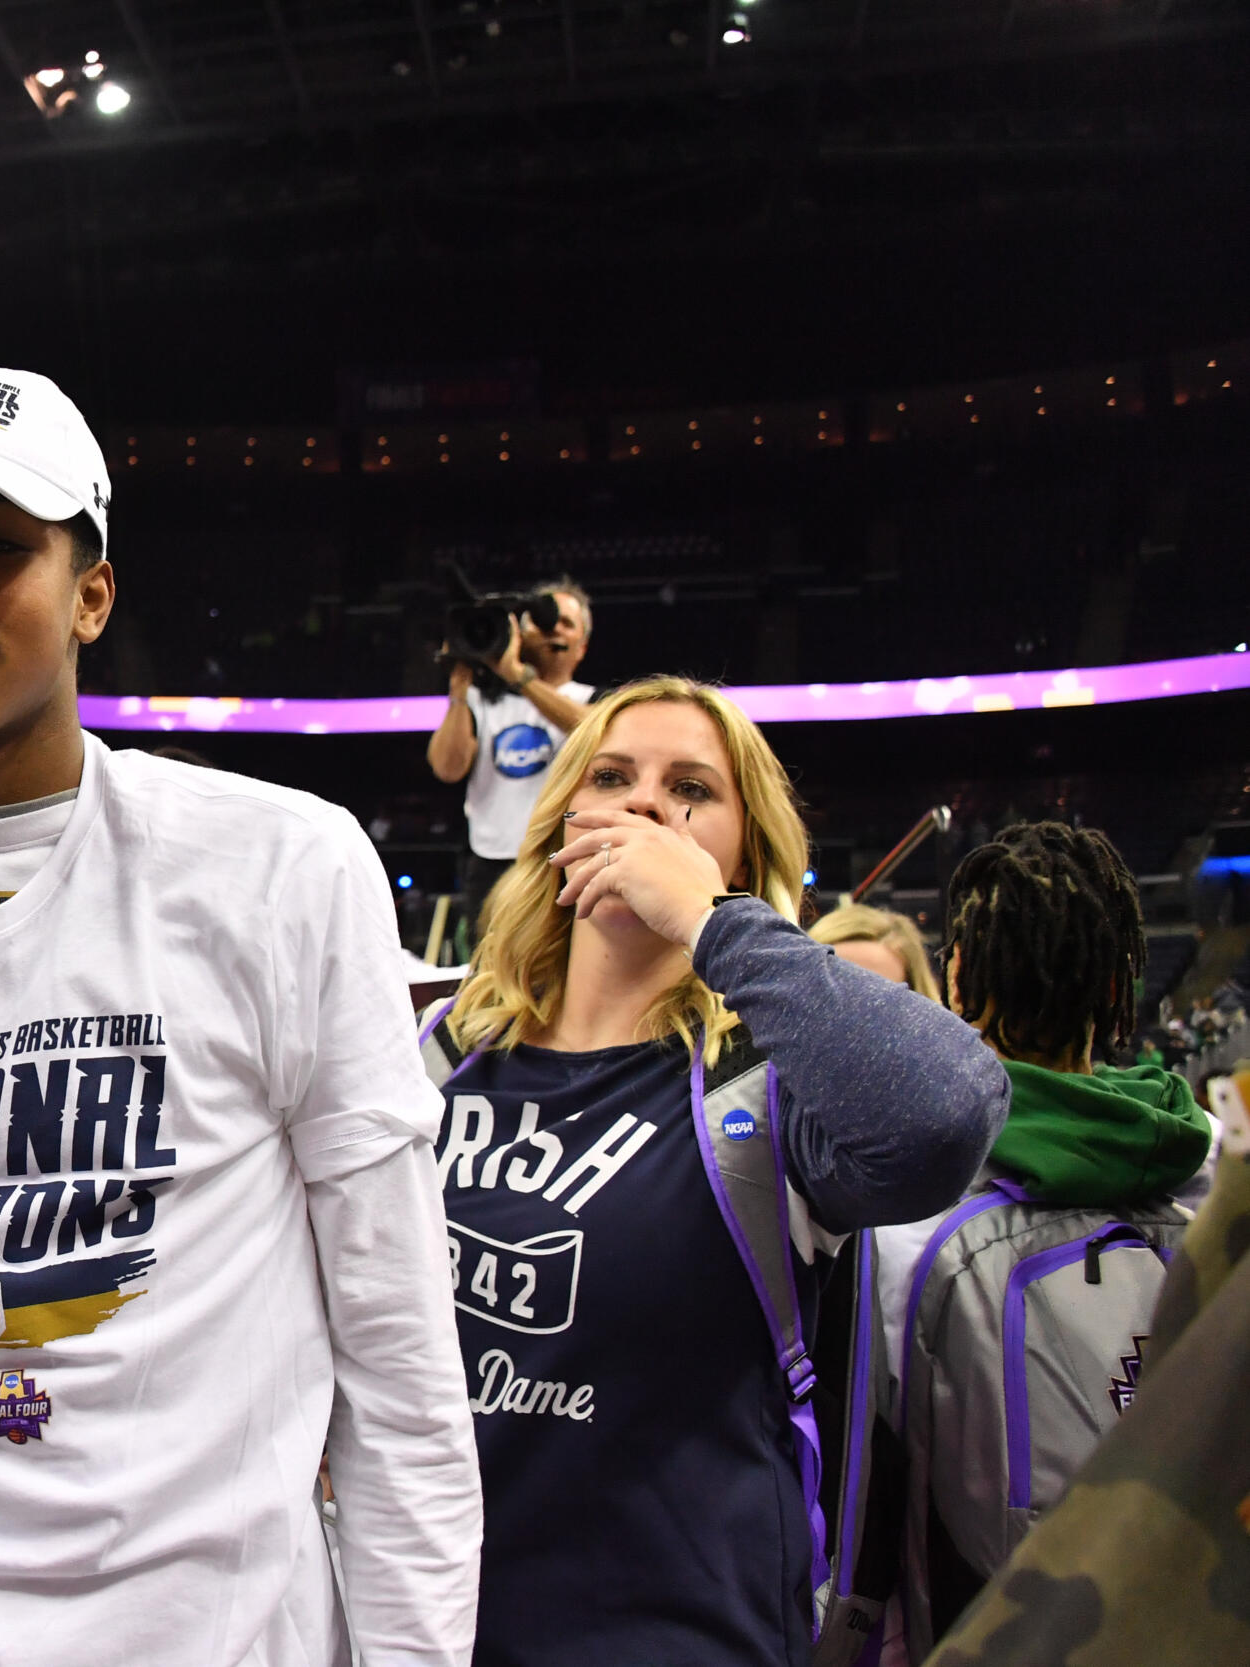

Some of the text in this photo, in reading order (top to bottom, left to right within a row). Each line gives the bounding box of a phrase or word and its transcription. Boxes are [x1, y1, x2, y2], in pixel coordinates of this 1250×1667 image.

[12, 1013, 166, 1056] BASKETBALL
[724, 1121, 754, 1135] NCAA
[438, 1094, 658, 1215] RISH
[469, 1348, 595, 1421] Dame
[15, 1401, 48, 1417] FOUR
